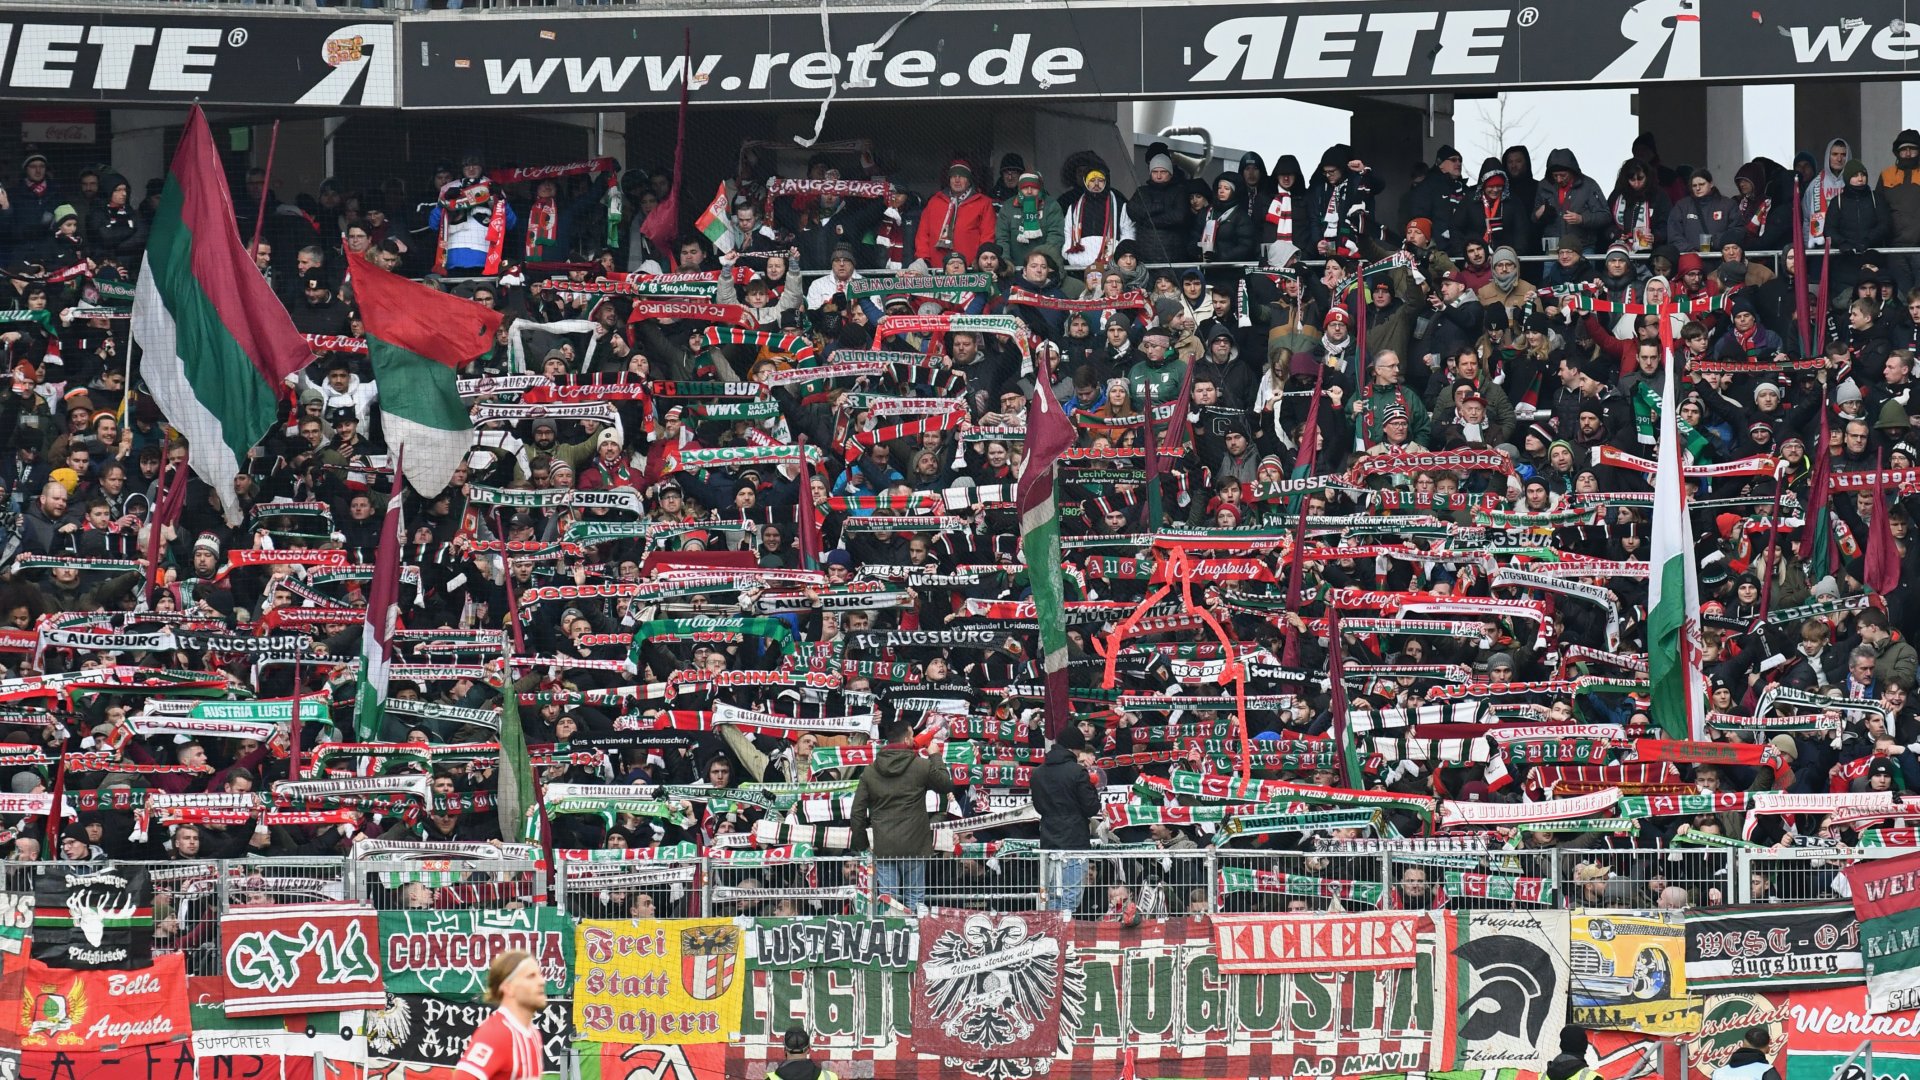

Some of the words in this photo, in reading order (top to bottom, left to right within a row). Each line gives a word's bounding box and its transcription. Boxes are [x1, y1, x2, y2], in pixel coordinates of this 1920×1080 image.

[483, 33, 1085, 96] www.rete.de
[535, 160, 600, 178] Augsburg
[786, 179, 885, 196] AUGSBURG
[852, 273, 989, 294] SCHWABENPOWER
[638, 302, 708, 315] AUGSBURG
[708, 304, 725, 317] FC
[956, 316, 1018, 332] AUGSBURG
[566, 384, 642, 398] Augsburg
[705, 403, 742, 417] WWK
[1364, 458, 1391, 471] FC
[1392, 453, 1502, 468] AUGSBURG
[1715, 461, 1753, 472] JUNGS
[1078, 470, 1128, 479] LechPower
[500, 491, 537, 505] DER
[1167, 528, 1209, 537] AUGSBURG
[241, 550, 258, 563] FC
[260, 549, 329, 562] AUGSBURG
[772, 571, 816, 582] JUNGS
[970, 565, 998, 573] WEISS
[1189, 562, 1260, 580] Augsburg
[1499, 570, 1548, 585] AUGSBURG
[1455, 597, 1539, 610] AUGSBURG
[1783, 603, 1826, 620] DER
[1833, 598, 1871, 611] FCA
[674, 617, 744, 632] Mitglied
[963, 621, 1001, 631] verbindet
[1400, 621, 1446, 631] AUGSBURG
[66, 631, 160, 647] AUGSBURG
[178, 635, 201, 651] FC
[207, 634, 310, 652] AUGSBURG
[857, 634, 880, 650] FC
[887, 630, 995, 646] AUGSBURG
[1251, 664, 1307, 681] Sortimo
[889, 682, 931, 693] verbindet
[1609, 678, 1639, 687] WEISS
[1431, 682, 1580, 700] AUGSBURG
[203, 703, 252, 718] AUSTRIA
[386, 699, 416, 712] LOCK
[1766, 716, 1810, 725] AUGSBURG
[134, 720, 161, 732] FC
[164, 721, 270, 738] AUGSBURG
[1491, 728, 1511, 740] FC
[1512, 725, 1598, 739] AUGSBURG
[591, 737, 634, 746] verbindet
[635, 736, 690, 746] Leidenschaft
[342, 746, 370, 754] WEISS
[373, 746, 396, 754] SIND
[1100, 793, 1128, 806] FCA
[1299, 788, 1327, 799] WEISS
[1331, 792, 1354, 801] SIND
[1357, 794, 1394, 803] UNSERE
[1244, 815, 1298, 829] AUSTRIA
[1304, 811, 1372, 824] LUSTENAU
[65, 872, 128, 890] Augsburger
[1470, 914, 1542, 930] Augusta
[583, 927, 668, 964] Frei
[754, 919, 911, 968] LUSTENAU
[1219, 920, 1416, 961] KICKERS
[1696, 928, 1791, 957] WEST
[68, 945, 128, 964] Platzhirsche
[951, 961, 981, 976] Ultras
[1731, 953, 1839, 978] Augsburg
[107, 974, 161, 996] Bella
[585, 967, 671, 998] Statt
[582, 1003, 721, 1041] Bayern
[1573, 1006, 1628, 1026] CALL
[85, 1014, 173, 1043] Augusta
[197, 1036, 271, 1051] SUPPORTER
[1458, 1049, 1540, 1061] Skinheads
[1342, 1052, 1420, 1075] MMVII
